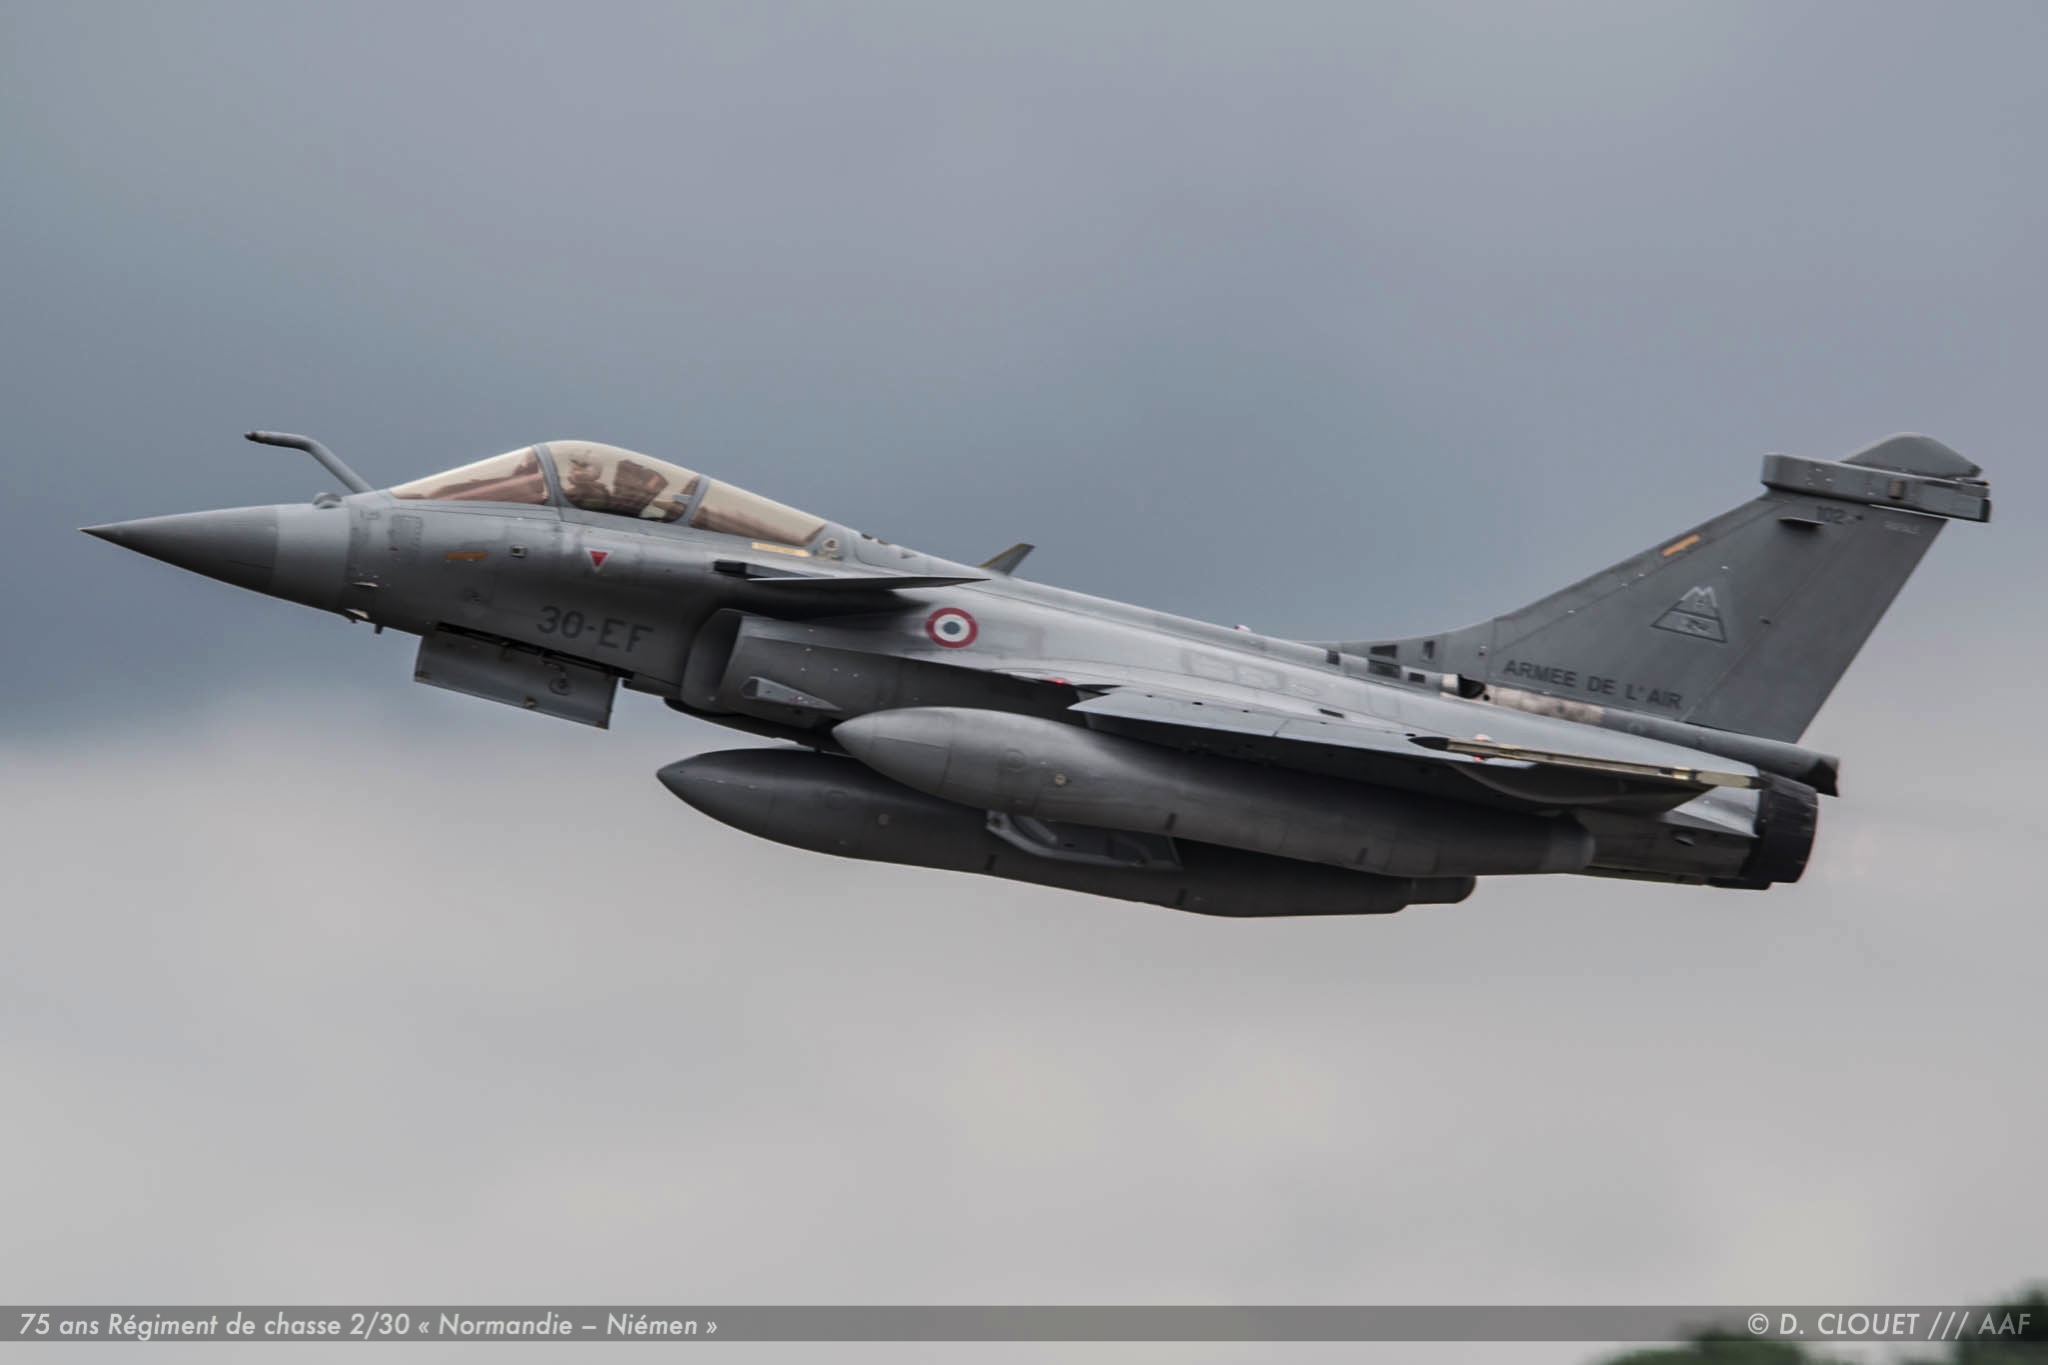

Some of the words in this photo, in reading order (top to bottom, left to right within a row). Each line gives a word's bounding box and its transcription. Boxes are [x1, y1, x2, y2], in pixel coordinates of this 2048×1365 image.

[536, 606, 655, 653] 30-EF
[1503, 659, 1577, 688] ARMEE
[1587, 675, 1616, 696] DE
[1625, 684, 1682, 709] L'AIR
